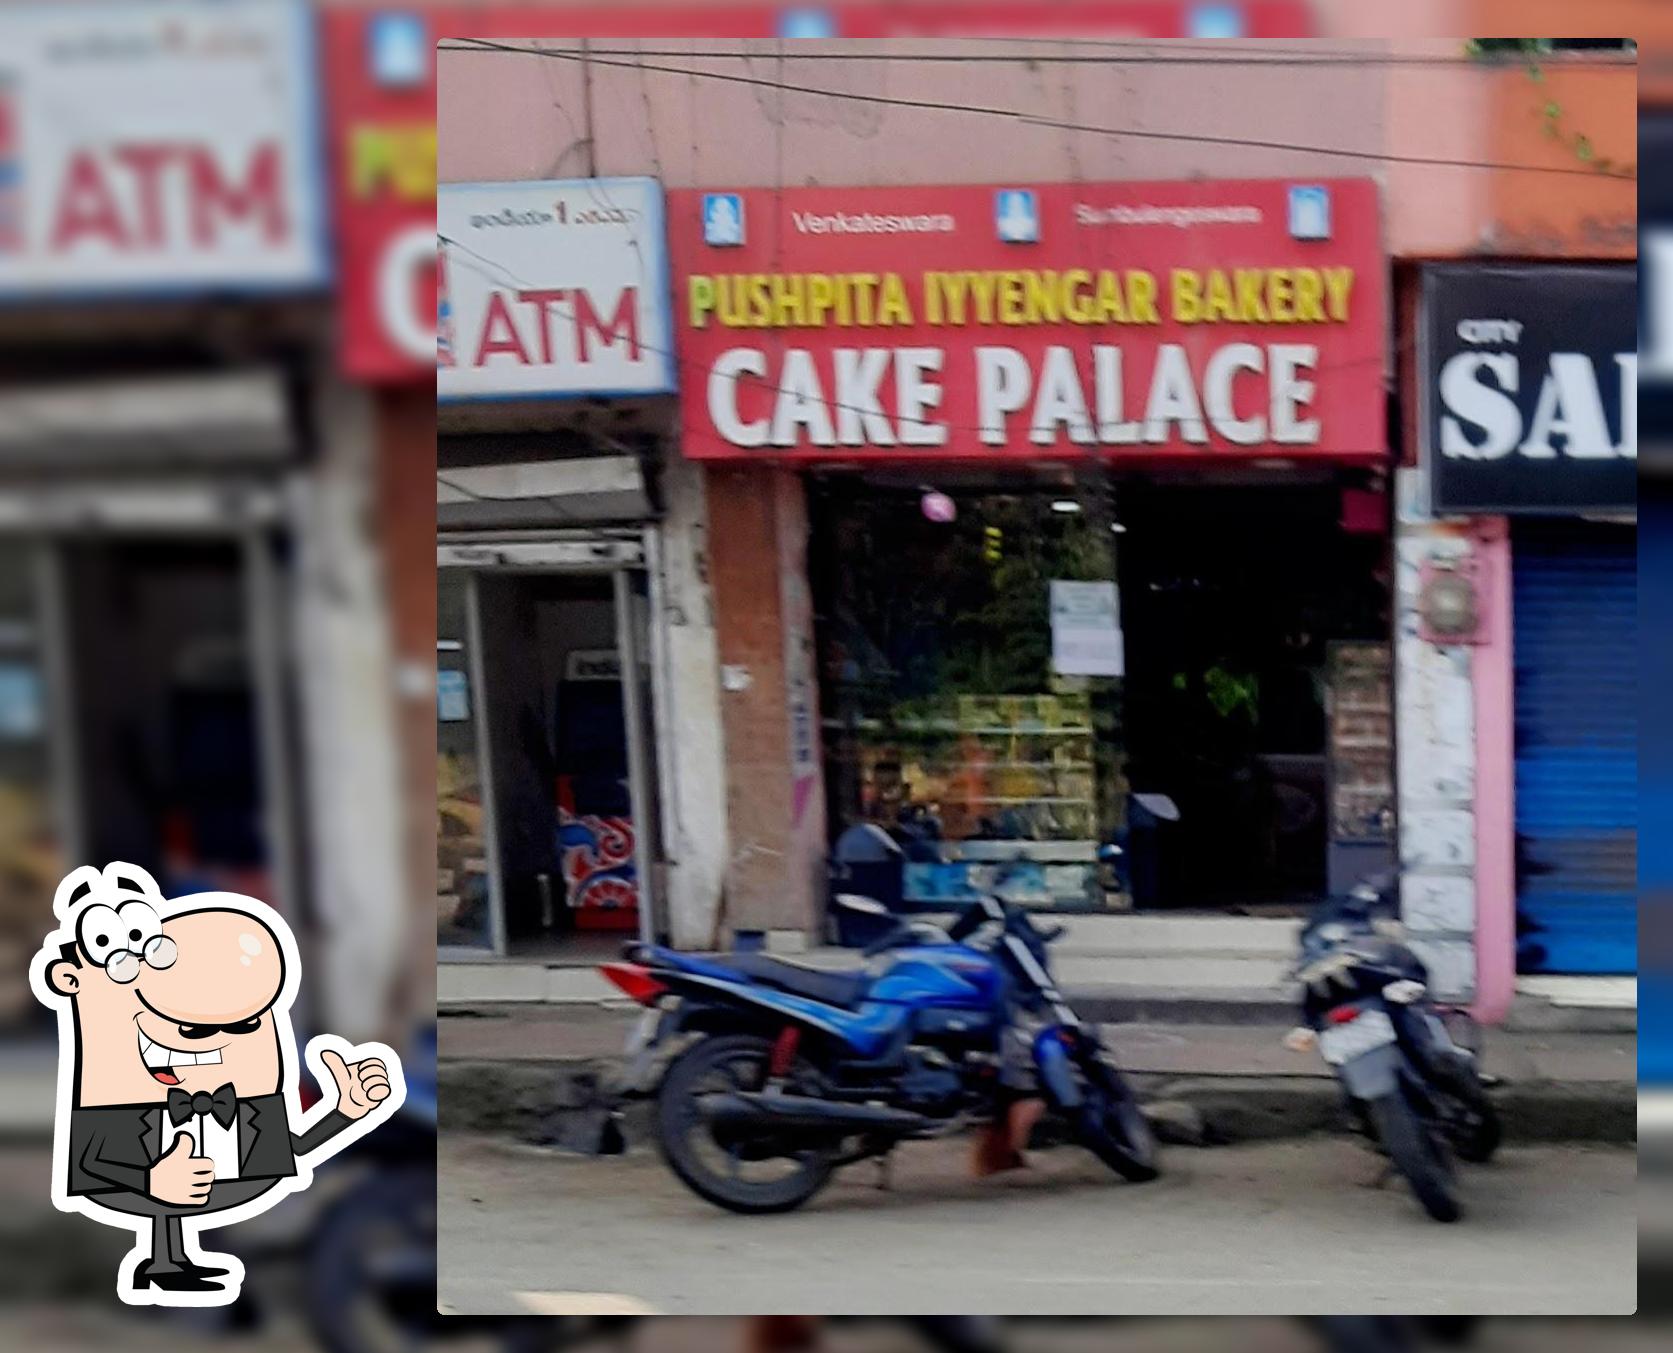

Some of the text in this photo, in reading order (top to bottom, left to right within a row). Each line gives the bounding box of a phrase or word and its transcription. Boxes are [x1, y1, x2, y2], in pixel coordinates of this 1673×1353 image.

[473, 286, 642, 367] ATM
[688, 267, 1355, 329] PUSHPITA IYYENGAR BAKERY
[706, 343, 1322, 448] CAKE PALACE
